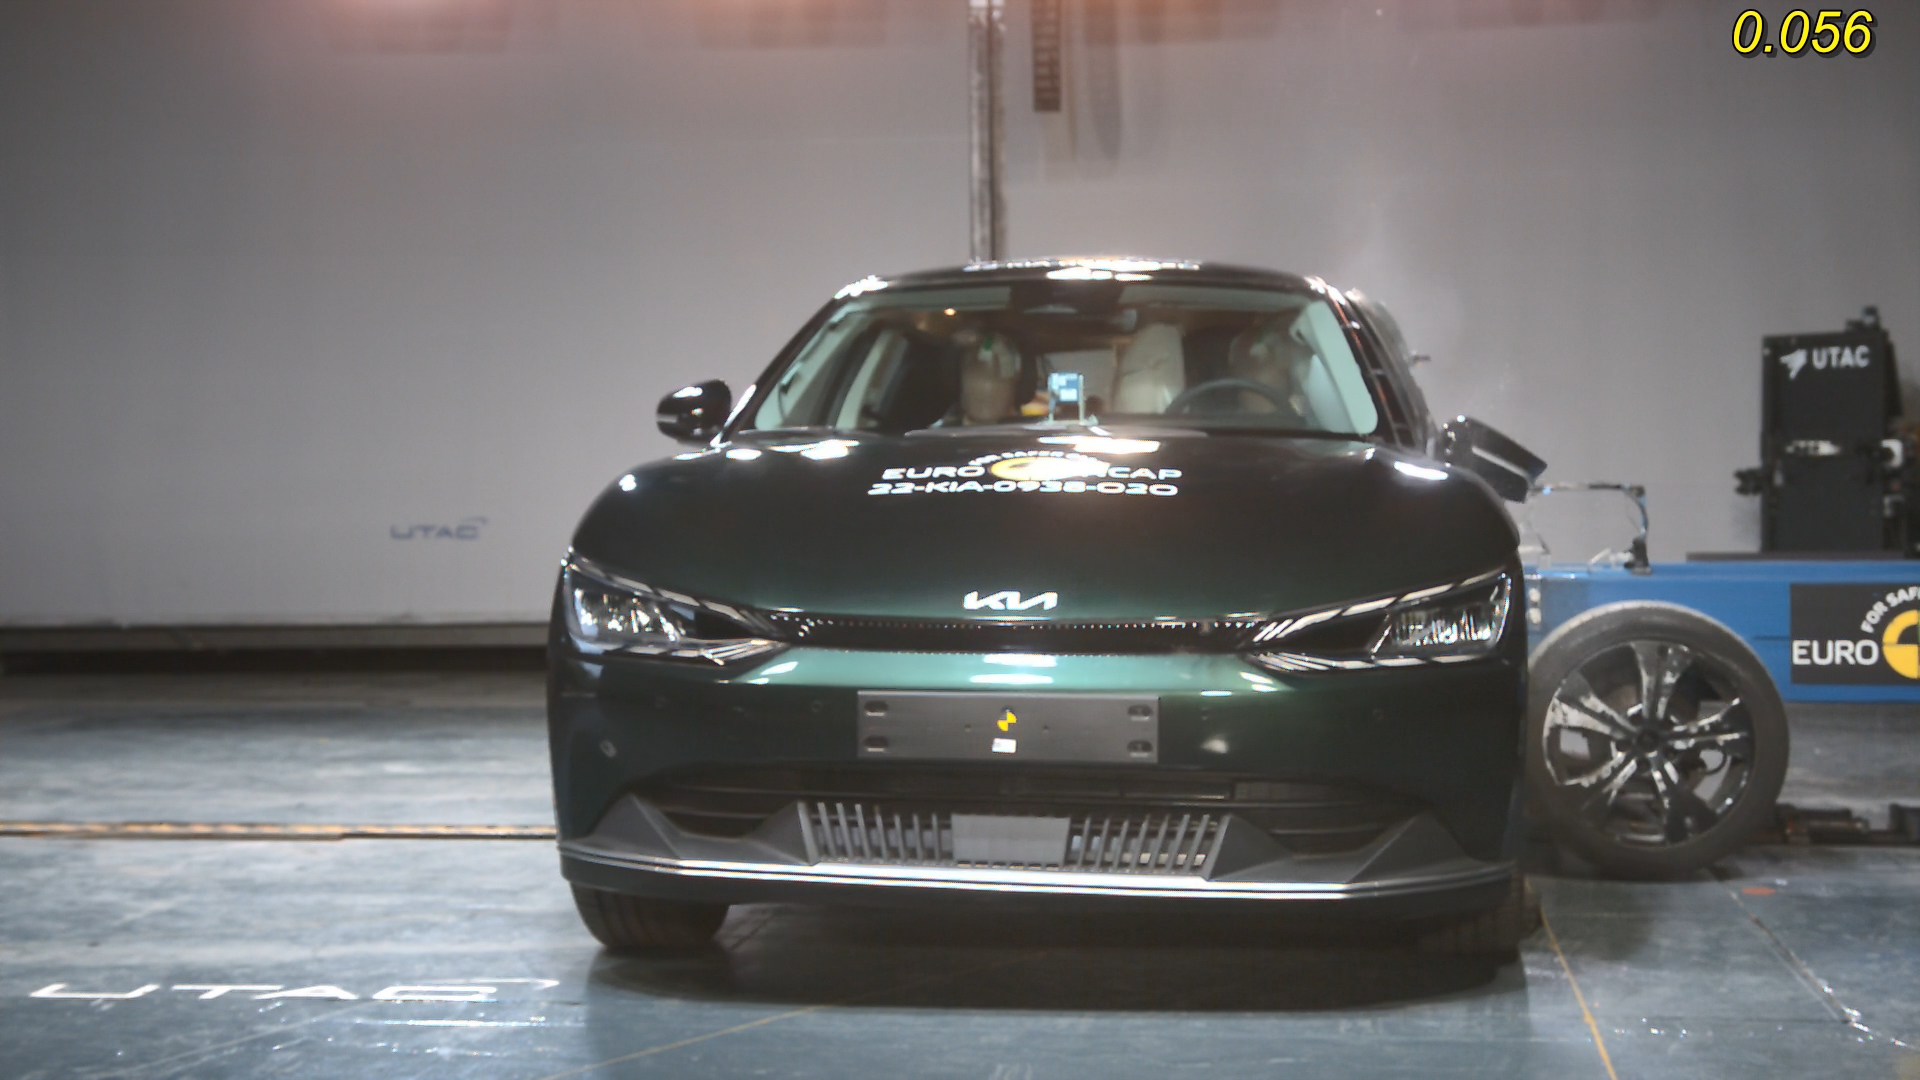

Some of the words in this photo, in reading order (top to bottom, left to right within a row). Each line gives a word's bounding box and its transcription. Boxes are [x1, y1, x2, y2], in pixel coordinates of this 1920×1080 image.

[1812, 345, 1870, 369] UTAC
[882, 466, 986, 480] EURO
[867, 480, 1179, 496] 22-KIA-0938-020
[389, 524, 479, 540] UTAC
[963, 591, 1058, 611] KIA
[1860, 601, 1888, 633] FOR
[1792, 639, 1879, 666] EURO
[29, 983, 499, 1001] UTAC
